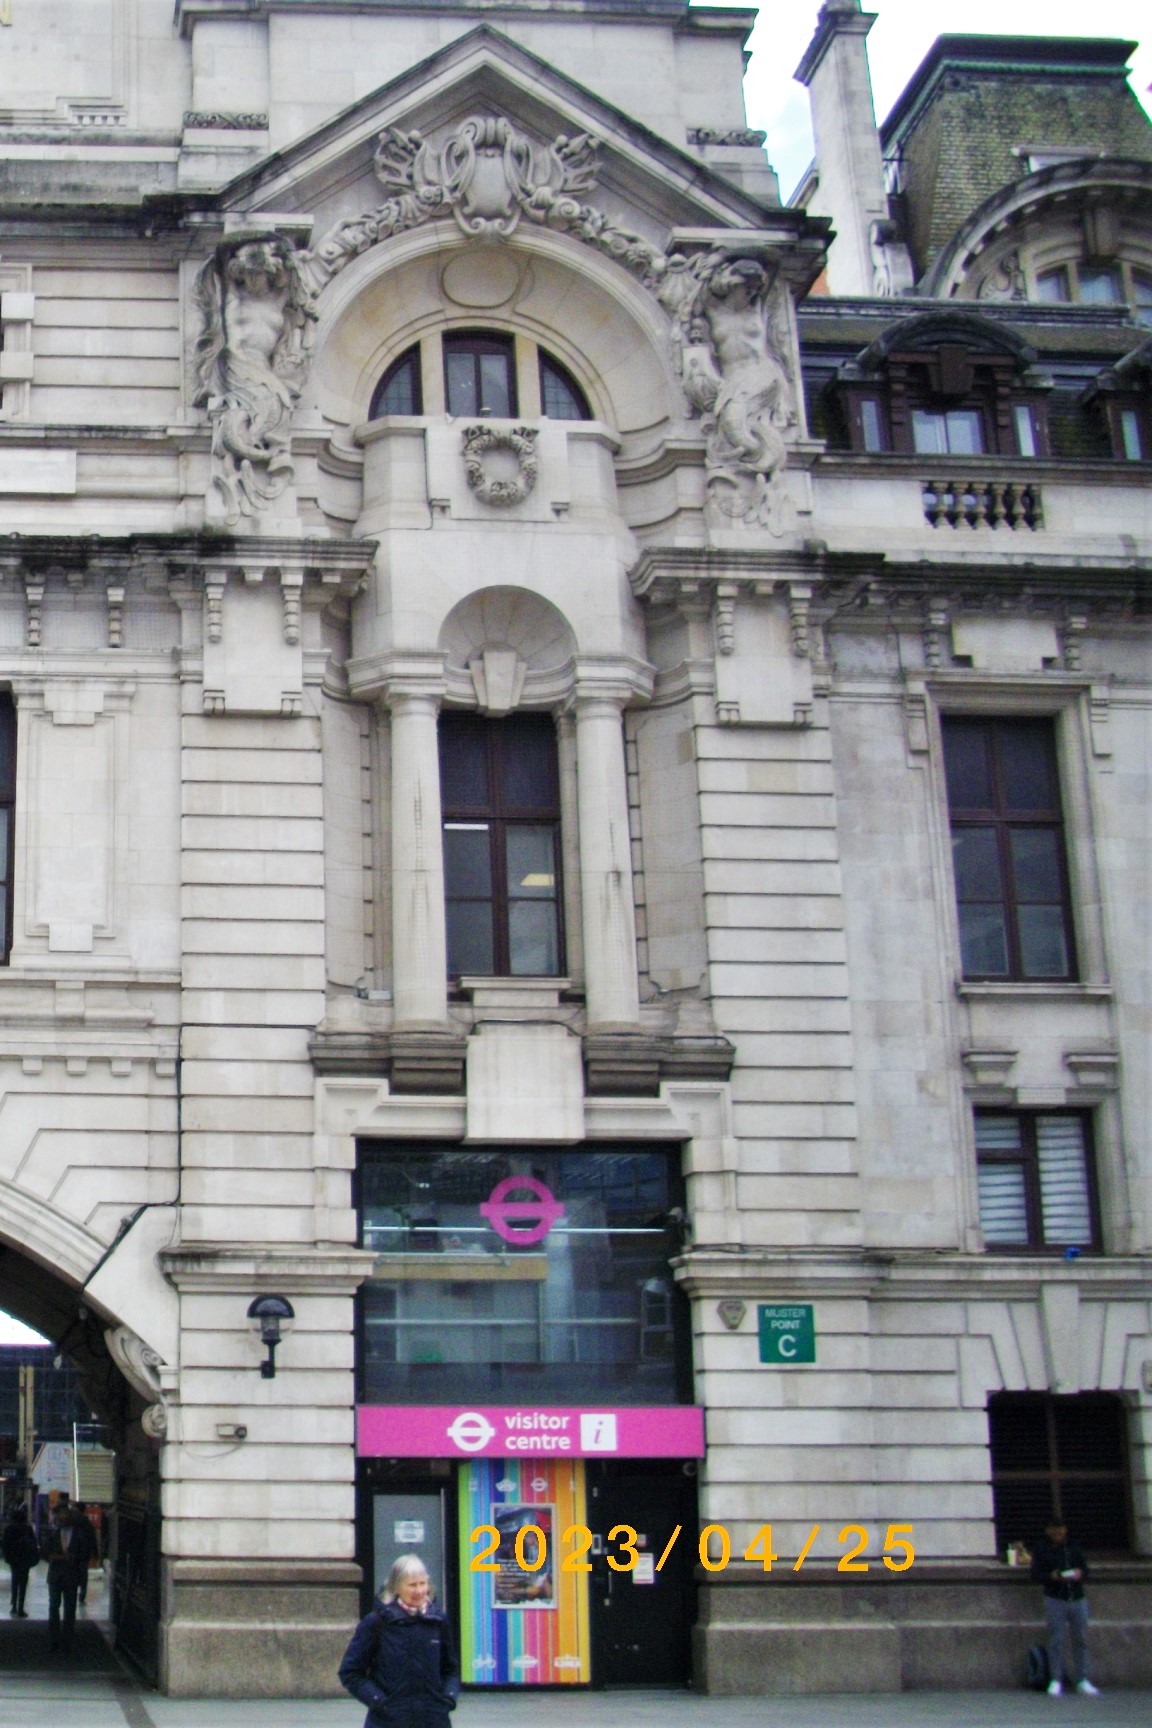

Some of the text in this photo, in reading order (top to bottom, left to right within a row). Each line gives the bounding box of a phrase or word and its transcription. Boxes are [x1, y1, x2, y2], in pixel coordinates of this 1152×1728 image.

[765, 1308, 806, 1318] MUSTER
[771, 1320, 800, 1329] POINT
[777, 1334, 797, 1357] C
[504, 1412, 570, 1429] visitor
[505, 1434, 571, 1450] centre
